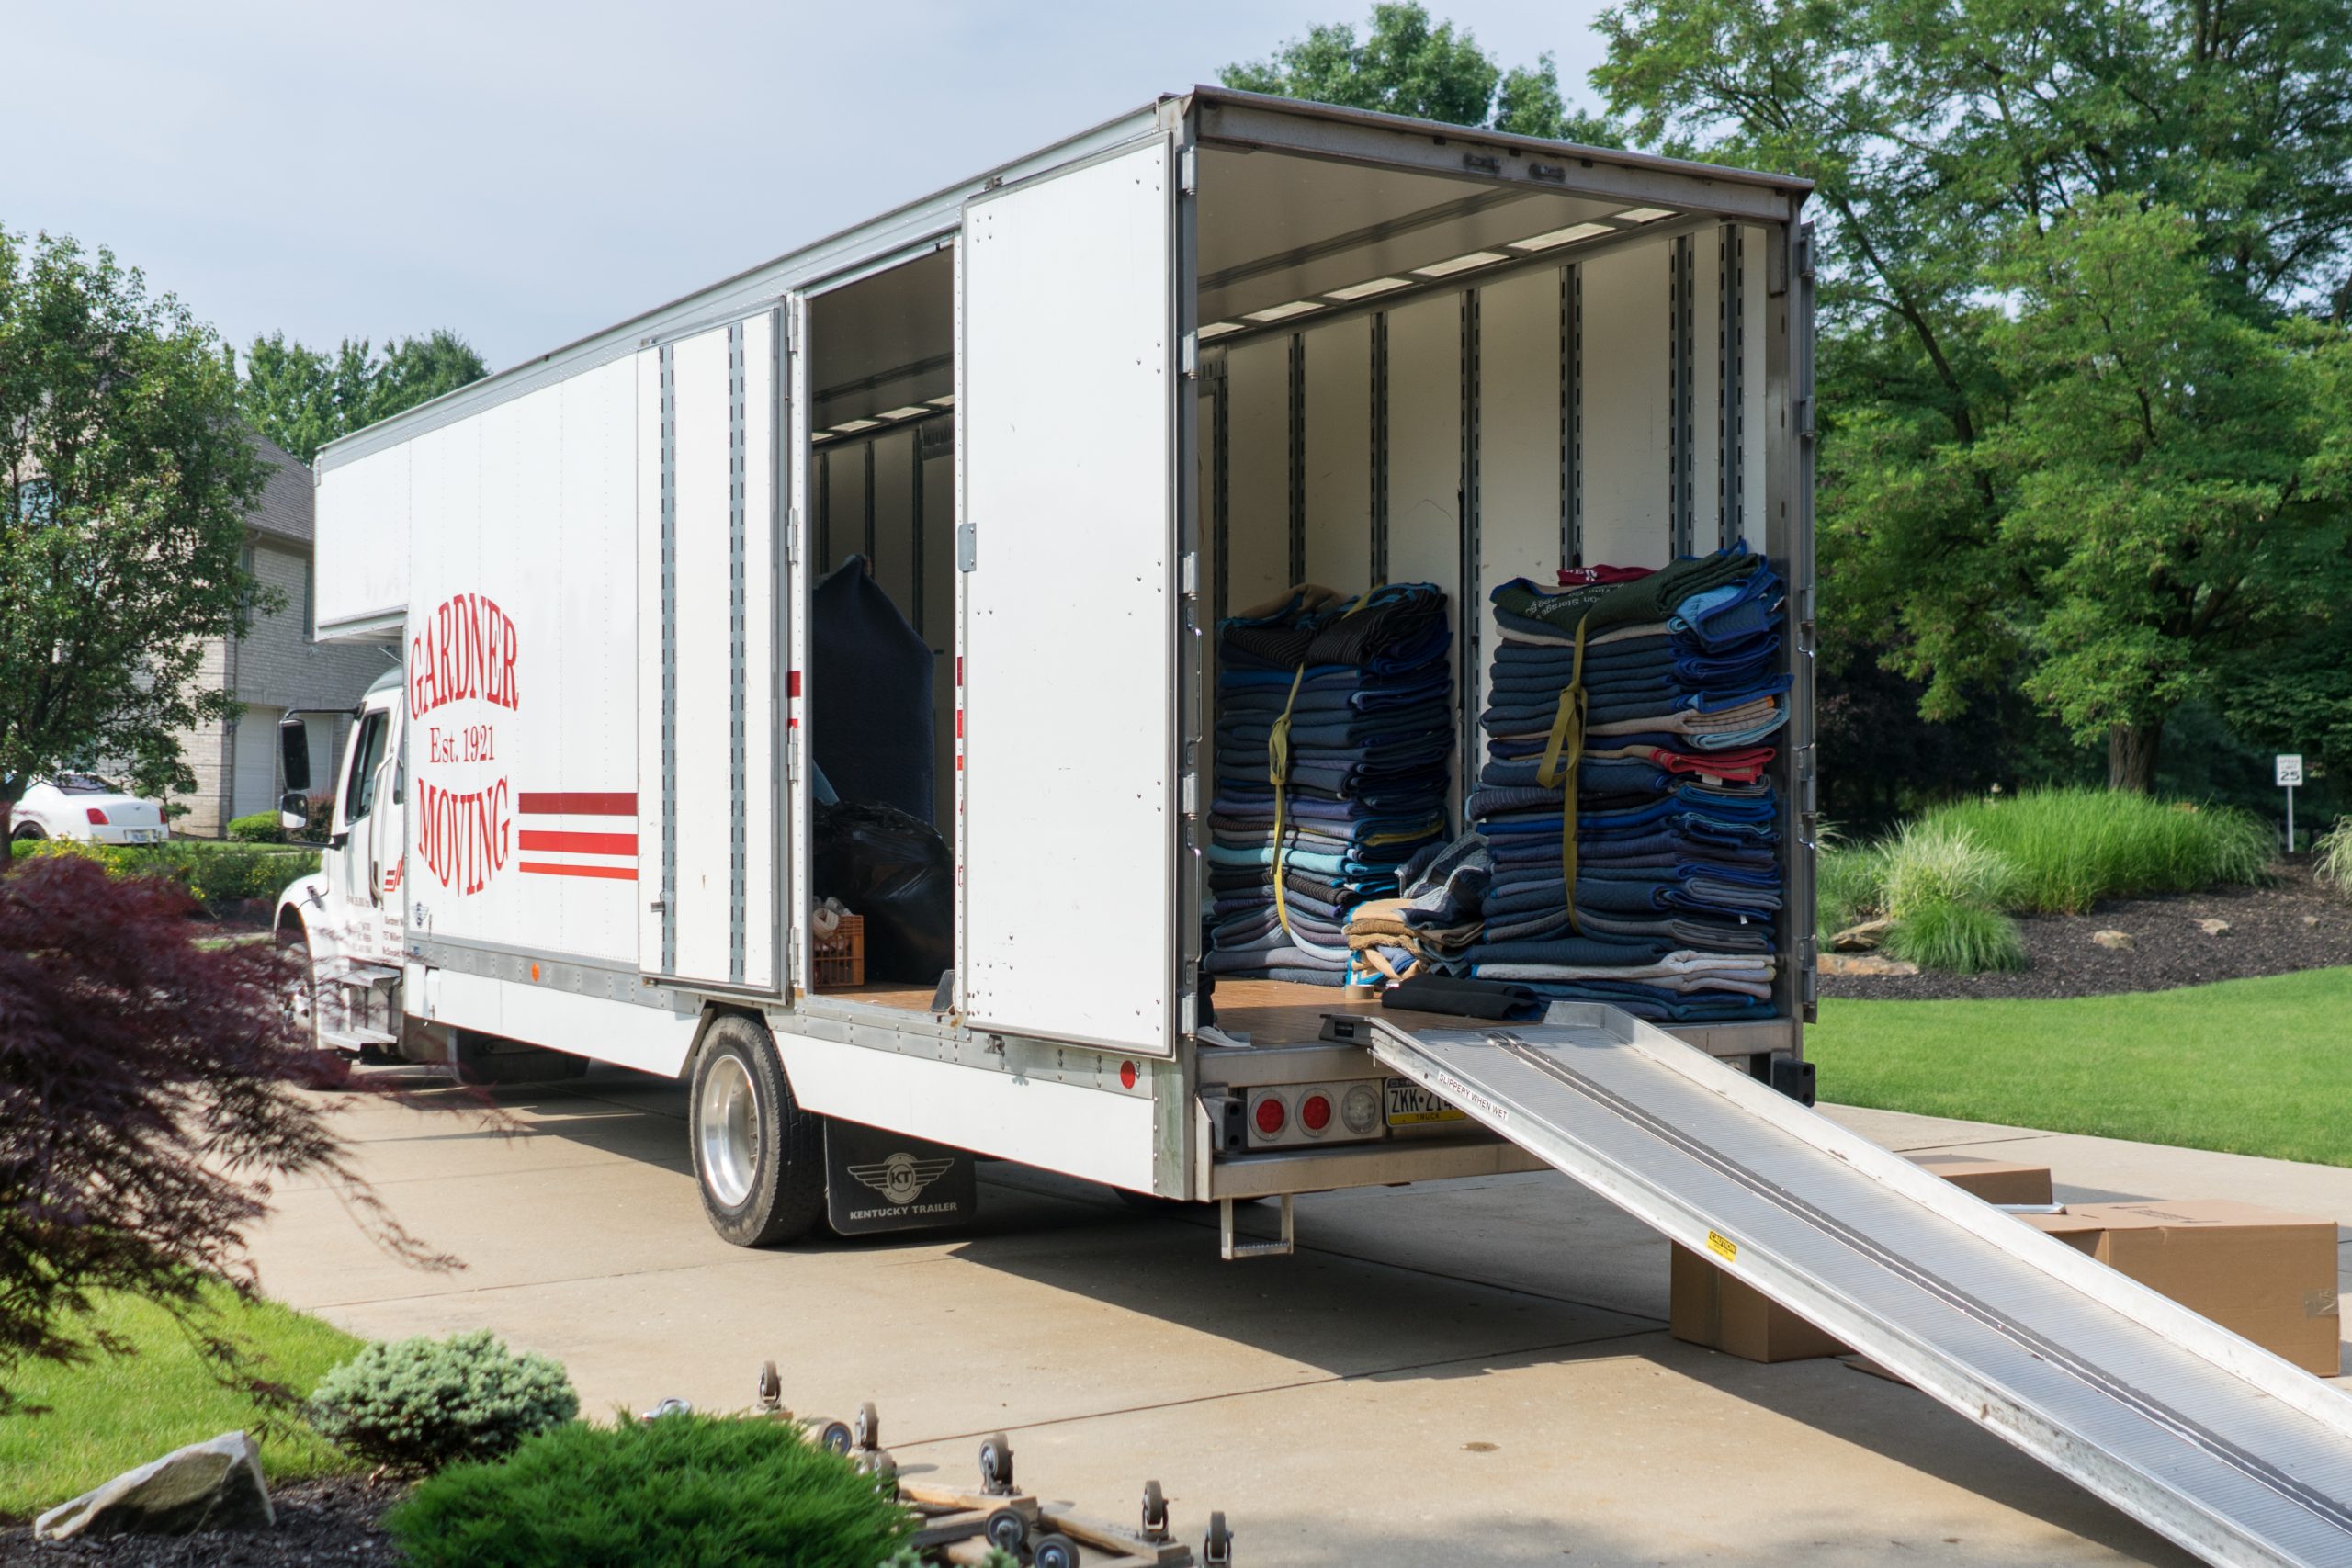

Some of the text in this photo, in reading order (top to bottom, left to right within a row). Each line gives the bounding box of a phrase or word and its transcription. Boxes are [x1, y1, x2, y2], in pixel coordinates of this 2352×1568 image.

[1541, 598, 1579, 616] Storage
[410, 592, 519, 720] GARDNER
[430, 725, 495, 763] Est. 1921
[2280, 771, 2300, 781] 25
[418, 775, 510, 897] MOVING
[1439, 1073, 1470, 1098] SLIPPERY
[1471, 1092, 1492, 1111] WHEN
[1492, 1104, 1507, 1120] WET
[890, 1170, 912, 1184] KT
[849, 1201, 958, 1220] KENTUCKY TRAILER
